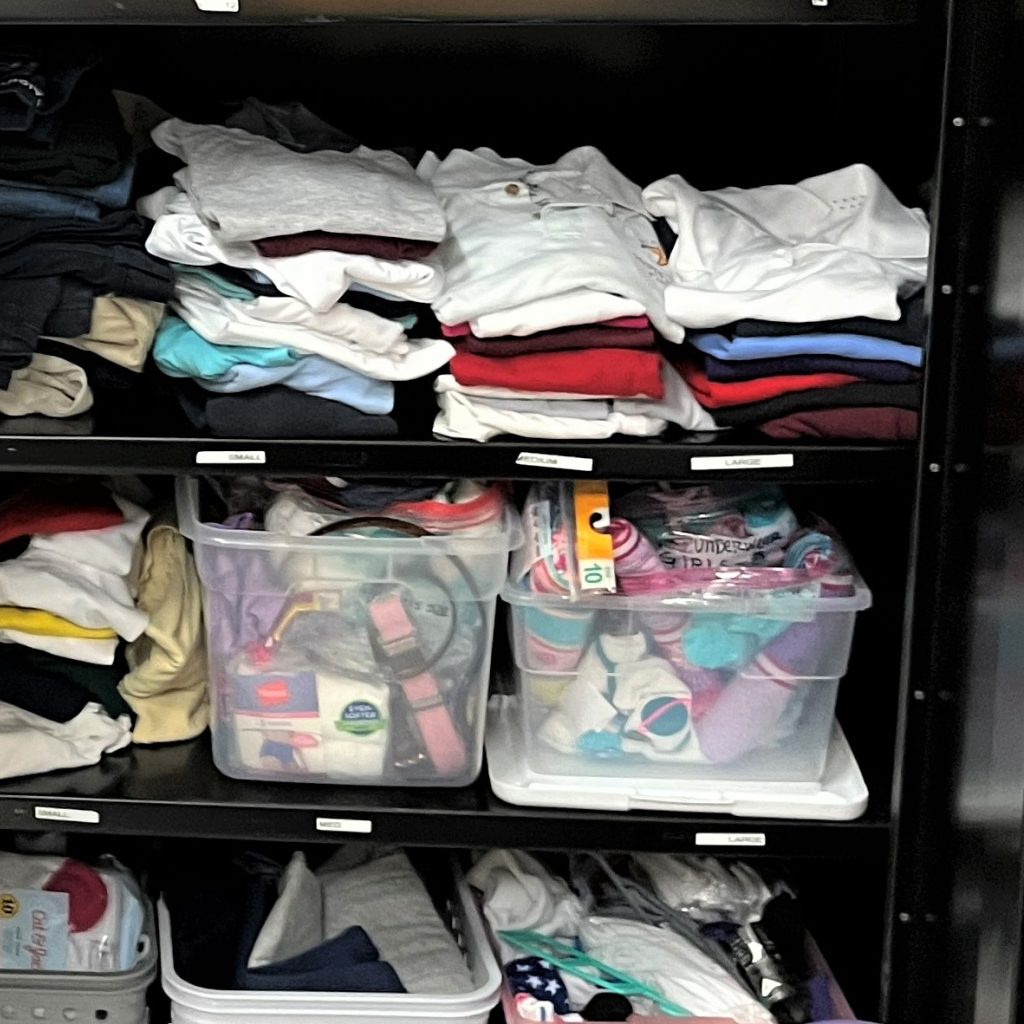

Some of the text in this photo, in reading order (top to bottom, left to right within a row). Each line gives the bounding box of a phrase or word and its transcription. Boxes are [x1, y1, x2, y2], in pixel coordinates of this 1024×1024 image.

[227, 453, 262, 462] SMALL
[724, 458, 762, 467] LARGE
[583, 562, 603, 584] 10
[0, 899, 15, 915] 10
